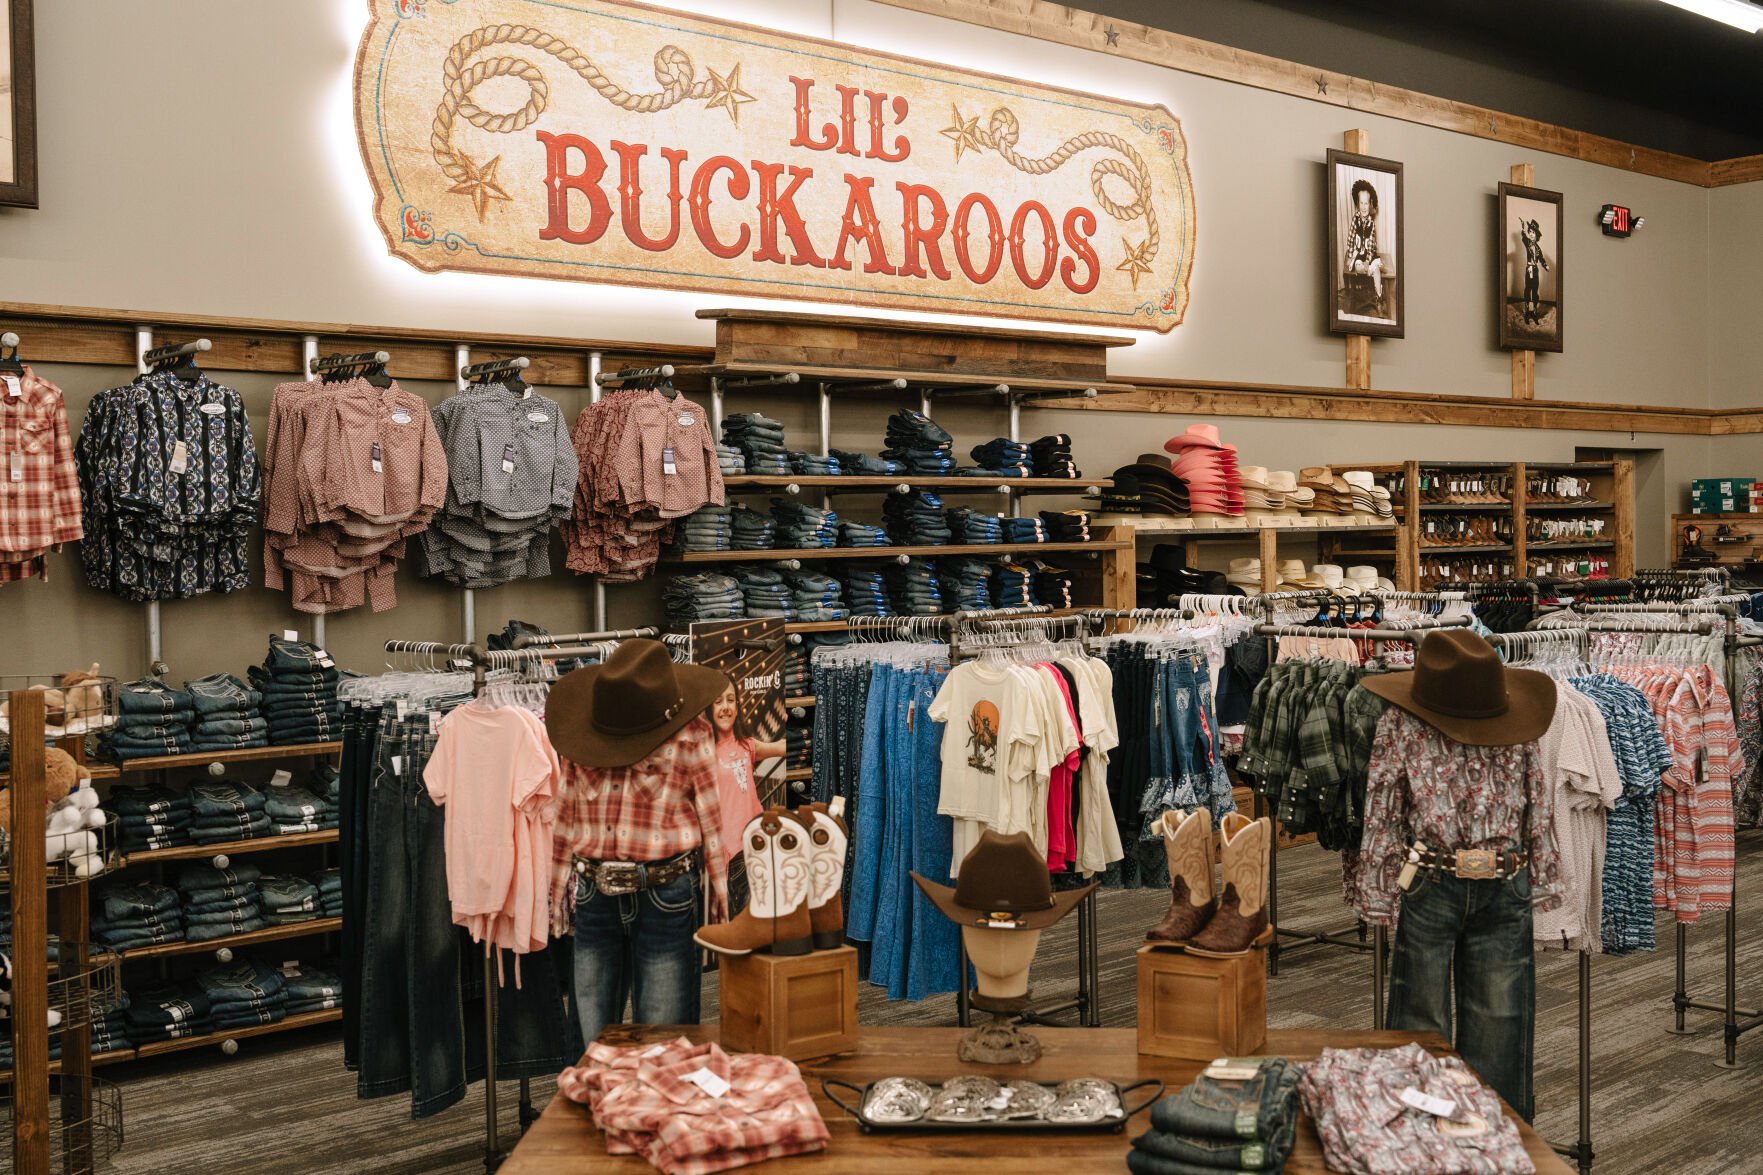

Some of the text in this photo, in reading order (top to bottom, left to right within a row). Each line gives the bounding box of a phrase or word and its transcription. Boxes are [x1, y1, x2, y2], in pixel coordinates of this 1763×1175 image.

[788, 75, 911, 163] LIL'
[536, 130, 1101, 294] BUCKAROOS
[1612, 206, 1629, 232] EXIT
